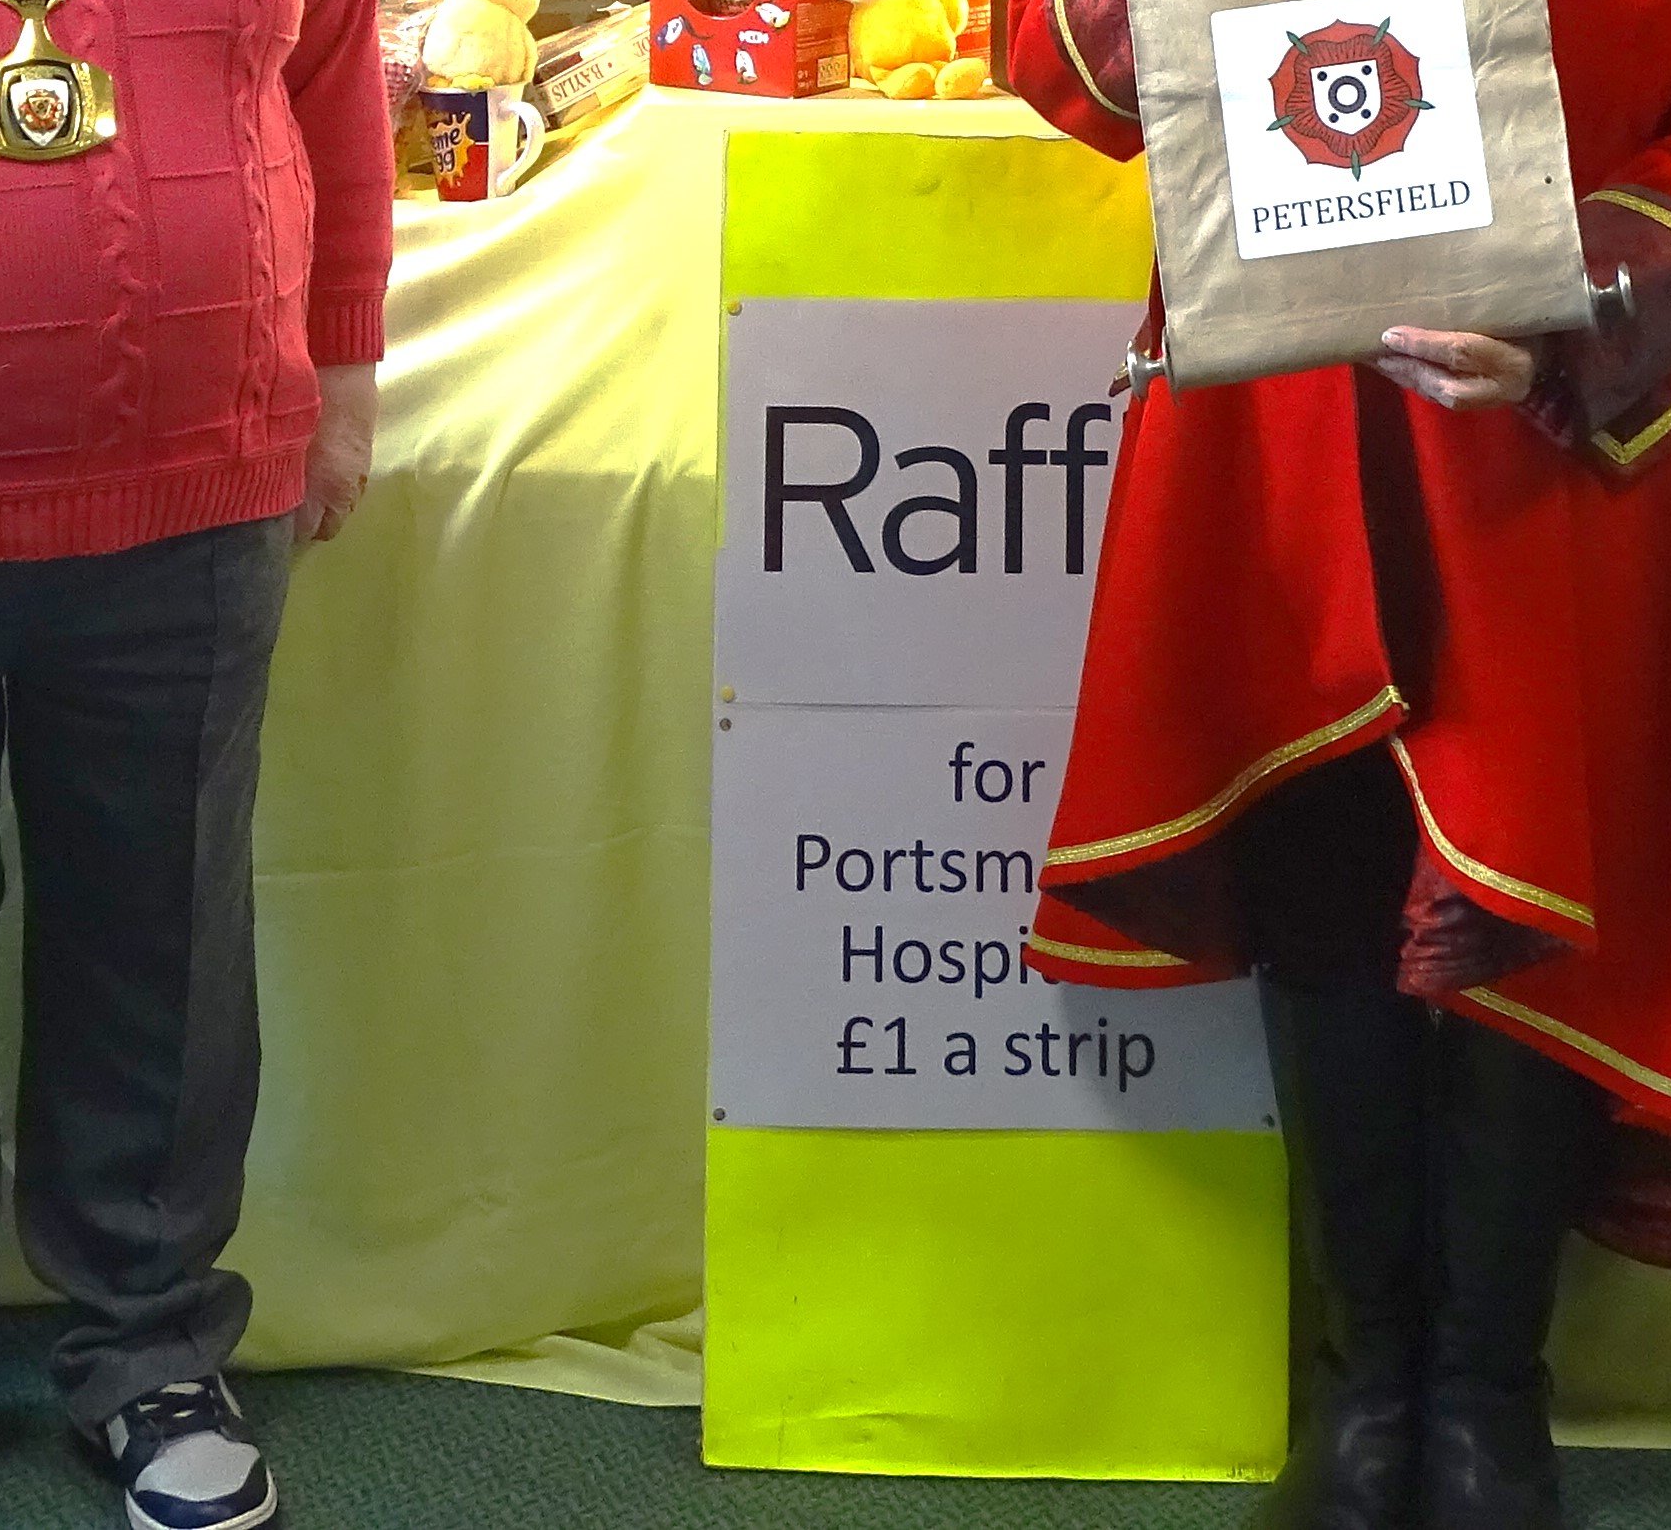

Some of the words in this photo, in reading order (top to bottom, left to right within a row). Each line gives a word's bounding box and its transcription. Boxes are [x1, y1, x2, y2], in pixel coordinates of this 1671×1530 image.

[551, 63, 605, 103] BAYLIS
[1252, 180, 1471, 233] PETERSFIELD
[763, 402, 1113, 575] Raff
[949, 741, 1047, 804] for
[796, 834, 1034, 894] Portsm
[843, 925, 1060, 999] Hospi
[837, 1016, 917, 1077] £1
[945, 1031, 978, 1076] a
[1005, 1017, 1157, 1092] strip
